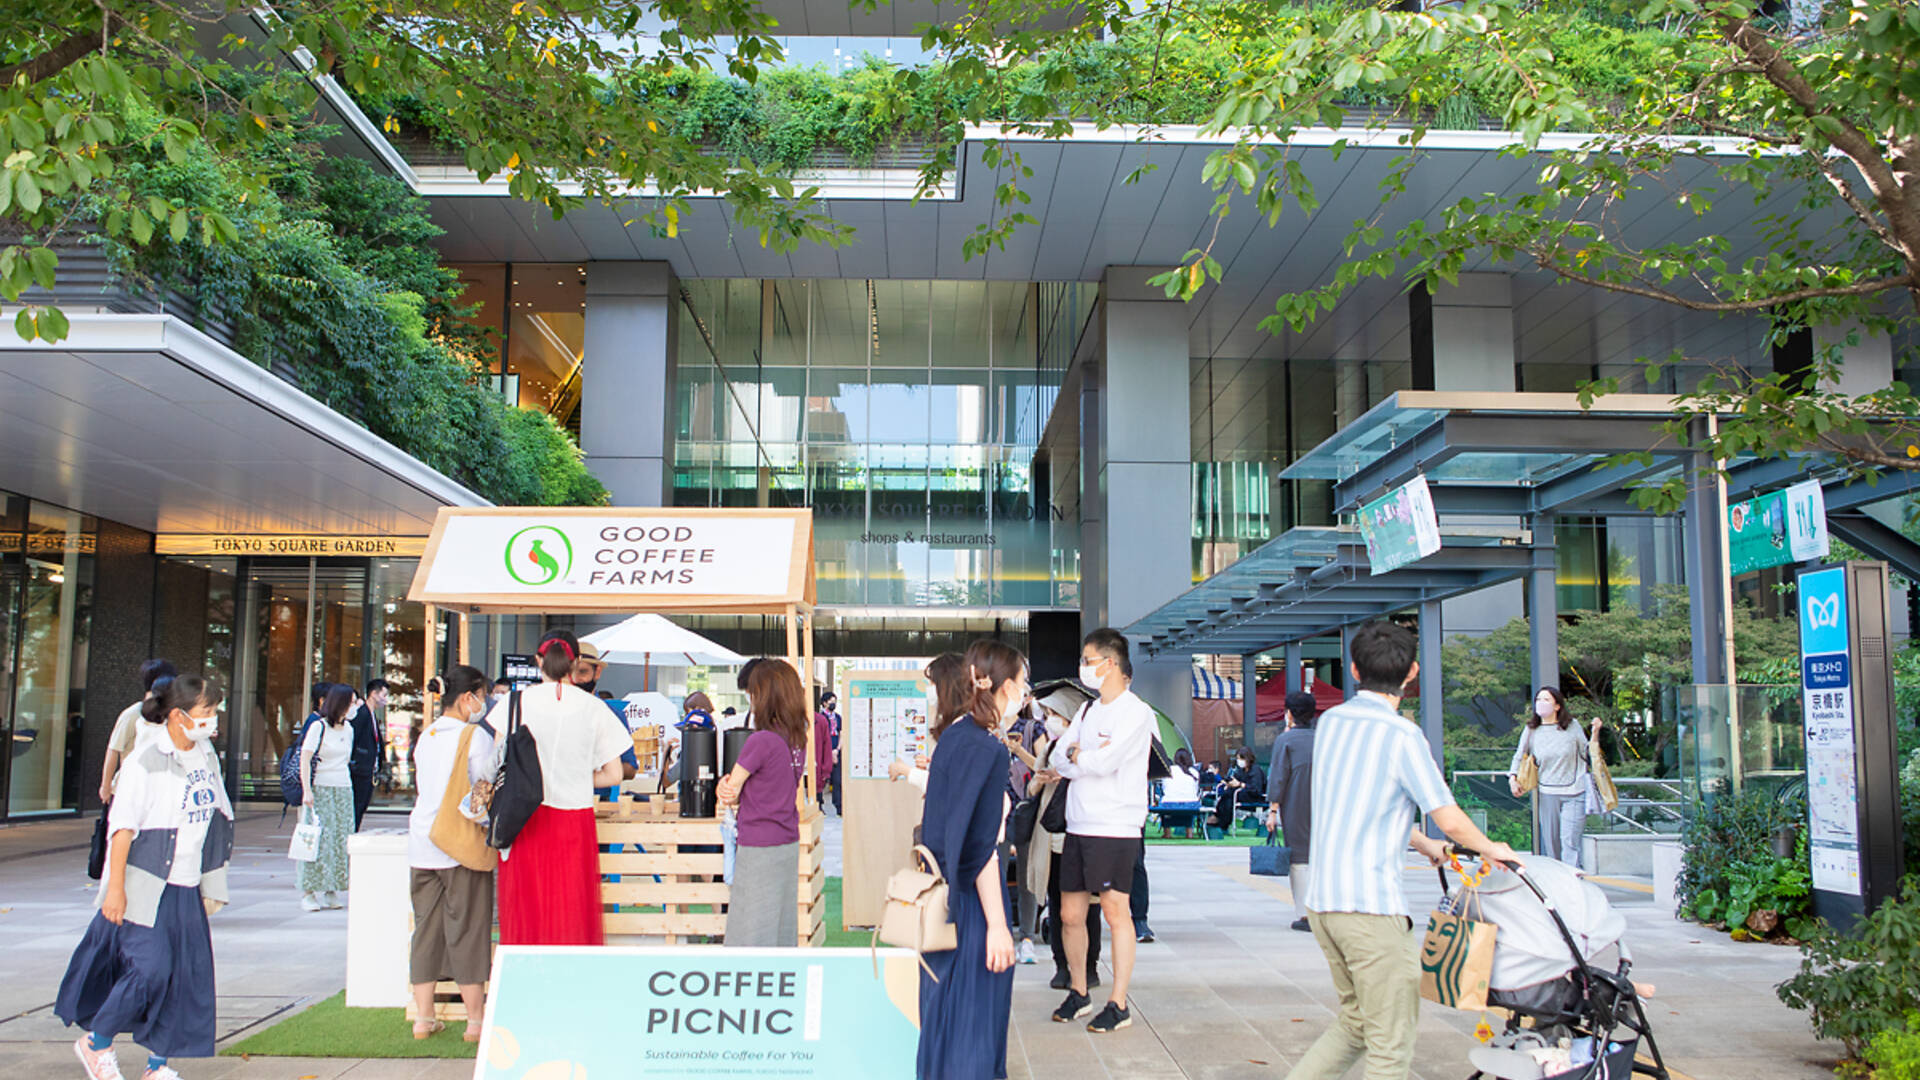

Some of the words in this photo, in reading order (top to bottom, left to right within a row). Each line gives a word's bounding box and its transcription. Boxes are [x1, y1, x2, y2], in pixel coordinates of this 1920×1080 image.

[599, 526, 693, 542] GOOD
[861, 531, 898, 545] shops
[904, 531, 914, 543] &
[920, 532, 996, 545] restaurants
[213, 539, 262, 551] TOKYO
[269, 539, 328, 552] SQUARE
[334, 540, 396, 552] GARDEN
[594, 549, 715, 564] COFFEE
[588, 569, 695, 585] FARMS
[1812, 692, 1844, 710] 京橋駅
[648, 970, 797, 997] COFFEE
[646, 1008, 794, 1035] PICNIC
[645, 1049, 719, 1060] Sustainable
[722, 1050, 764, 1061] Coffee
[766, 1050, 787, 1060] For
[790, 1050, 815, 1061] You
